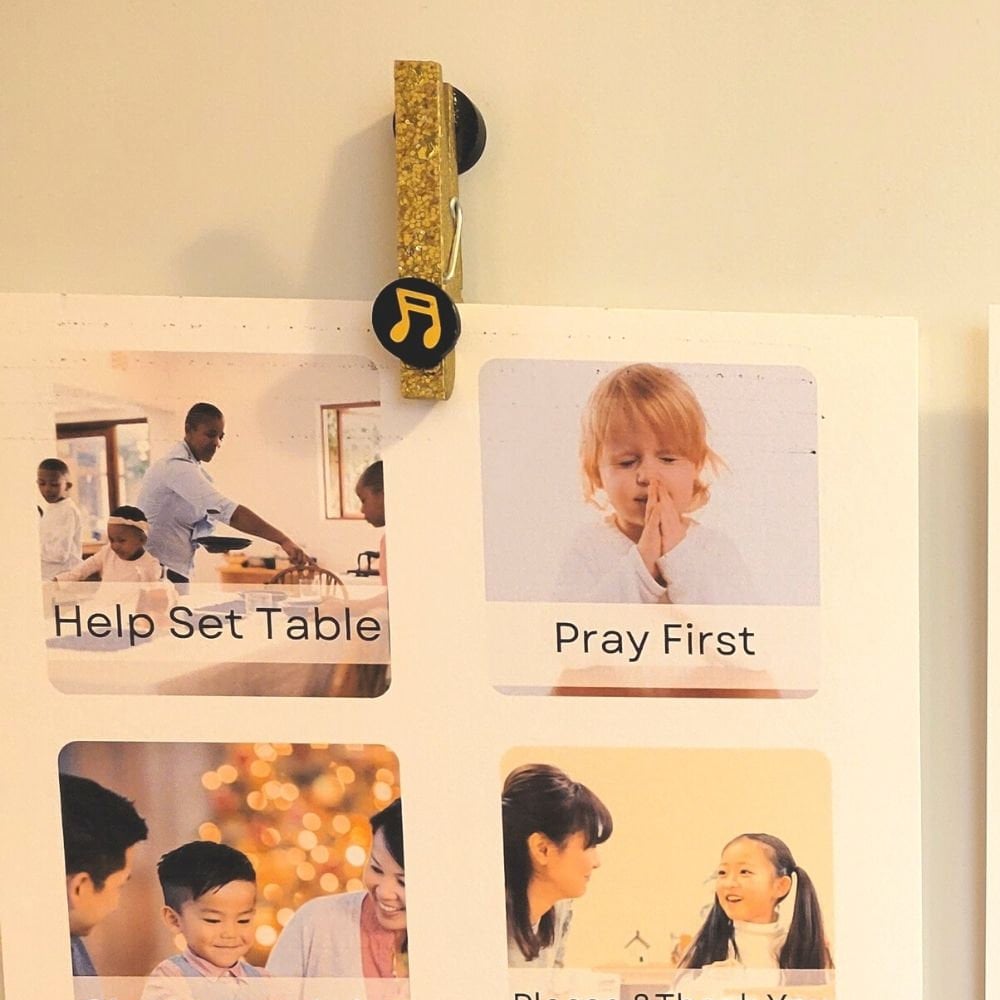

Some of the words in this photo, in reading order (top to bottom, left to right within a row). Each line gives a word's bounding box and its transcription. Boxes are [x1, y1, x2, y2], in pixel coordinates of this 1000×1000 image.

[54, 603, 155, 647] Help
[169, 606, 243, 640] Set
[255, 606, 381, 642] Table
[556, 622, 649, 663] Pray
[664, 622, 755, 656] First
